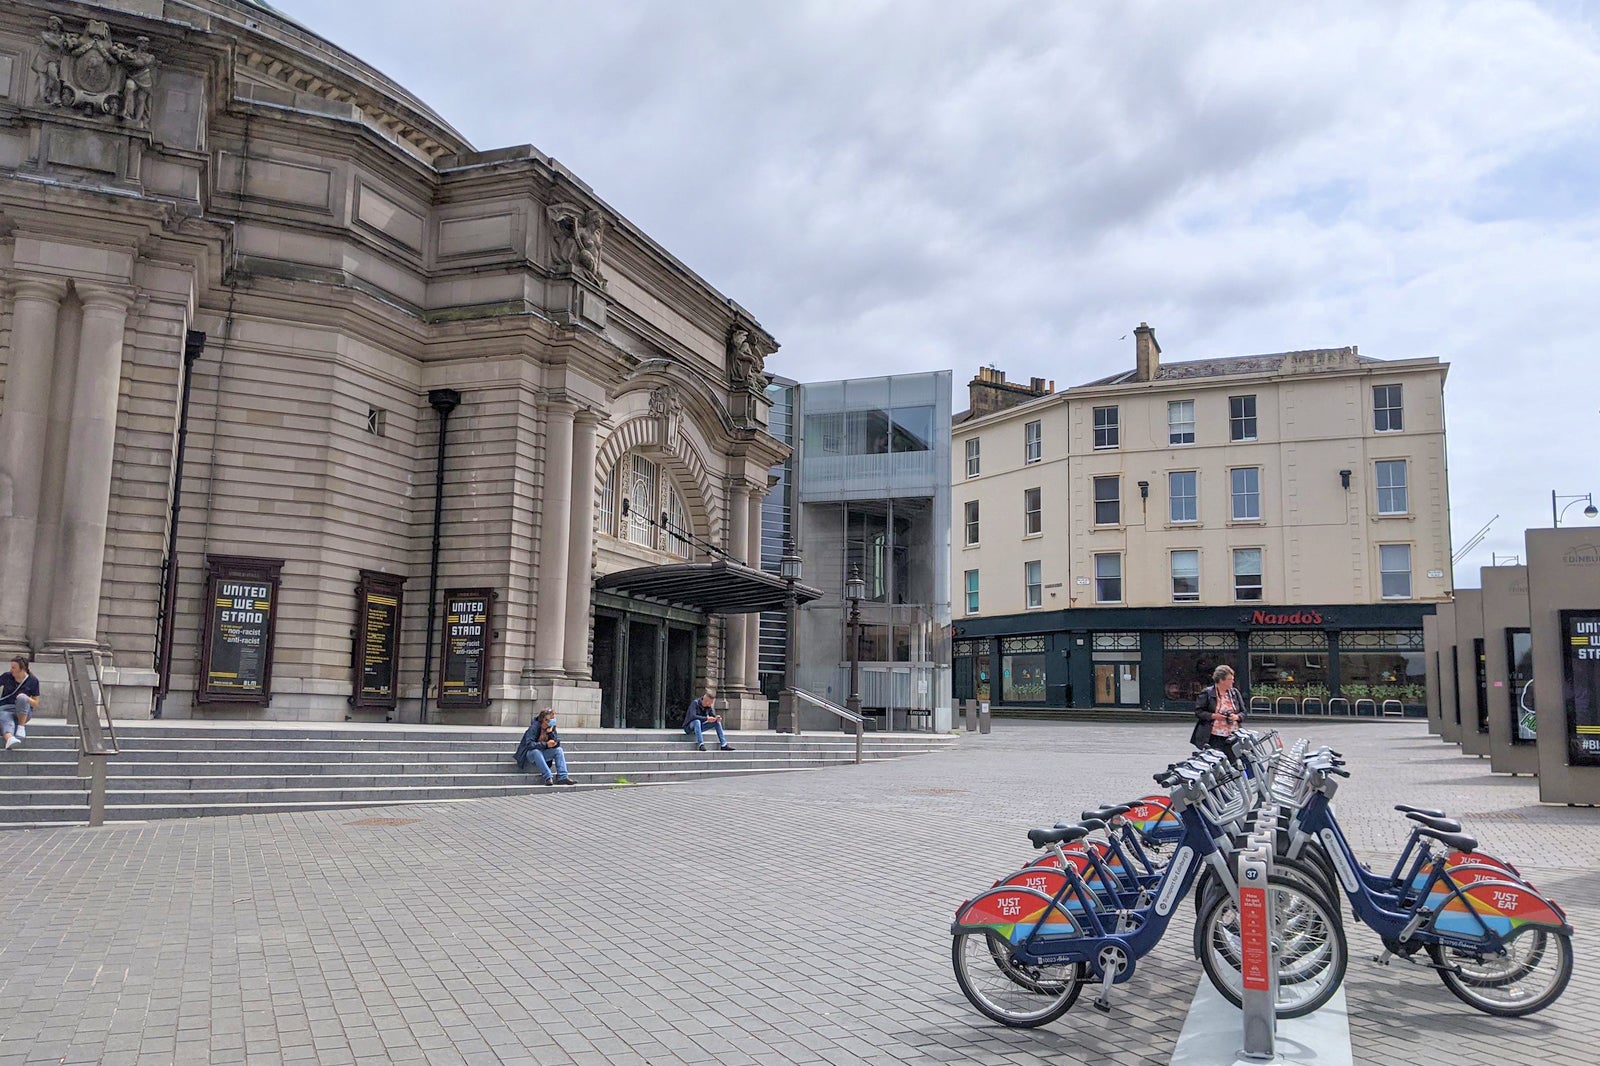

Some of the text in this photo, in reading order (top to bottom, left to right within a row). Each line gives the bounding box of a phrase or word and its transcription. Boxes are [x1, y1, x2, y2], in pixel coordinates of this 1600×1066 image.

[223, 584, 267, 598] UNITED
[233, 598, 254, 610] WE
[452, 602, 484, 612] UNITED
[221, 610, 263, 623] STAND
[460, 614, 474, 624] WE
[1251, 609, 1323, 625] Nando's
[227, 628, 261, 636] non-racist
[451, 625, 481, 636] STAND
[1577, 622, 1600, 633] UNI
[1460, 856, 1482, 865] JUST
[1163, 881, 1177, 904] Transport
[1175, 851, 1190, 875] Edinburgh
[1246, 870, 1256, 878] 37
[1026, 877, 1047, 888] JUST
[1493, 891, 1519, 902] JUST
[997, 897, 1020, 908] JUST
[1498, 901, 1518, 910] EAT
[1003, 906, 1021, 916] EAT
